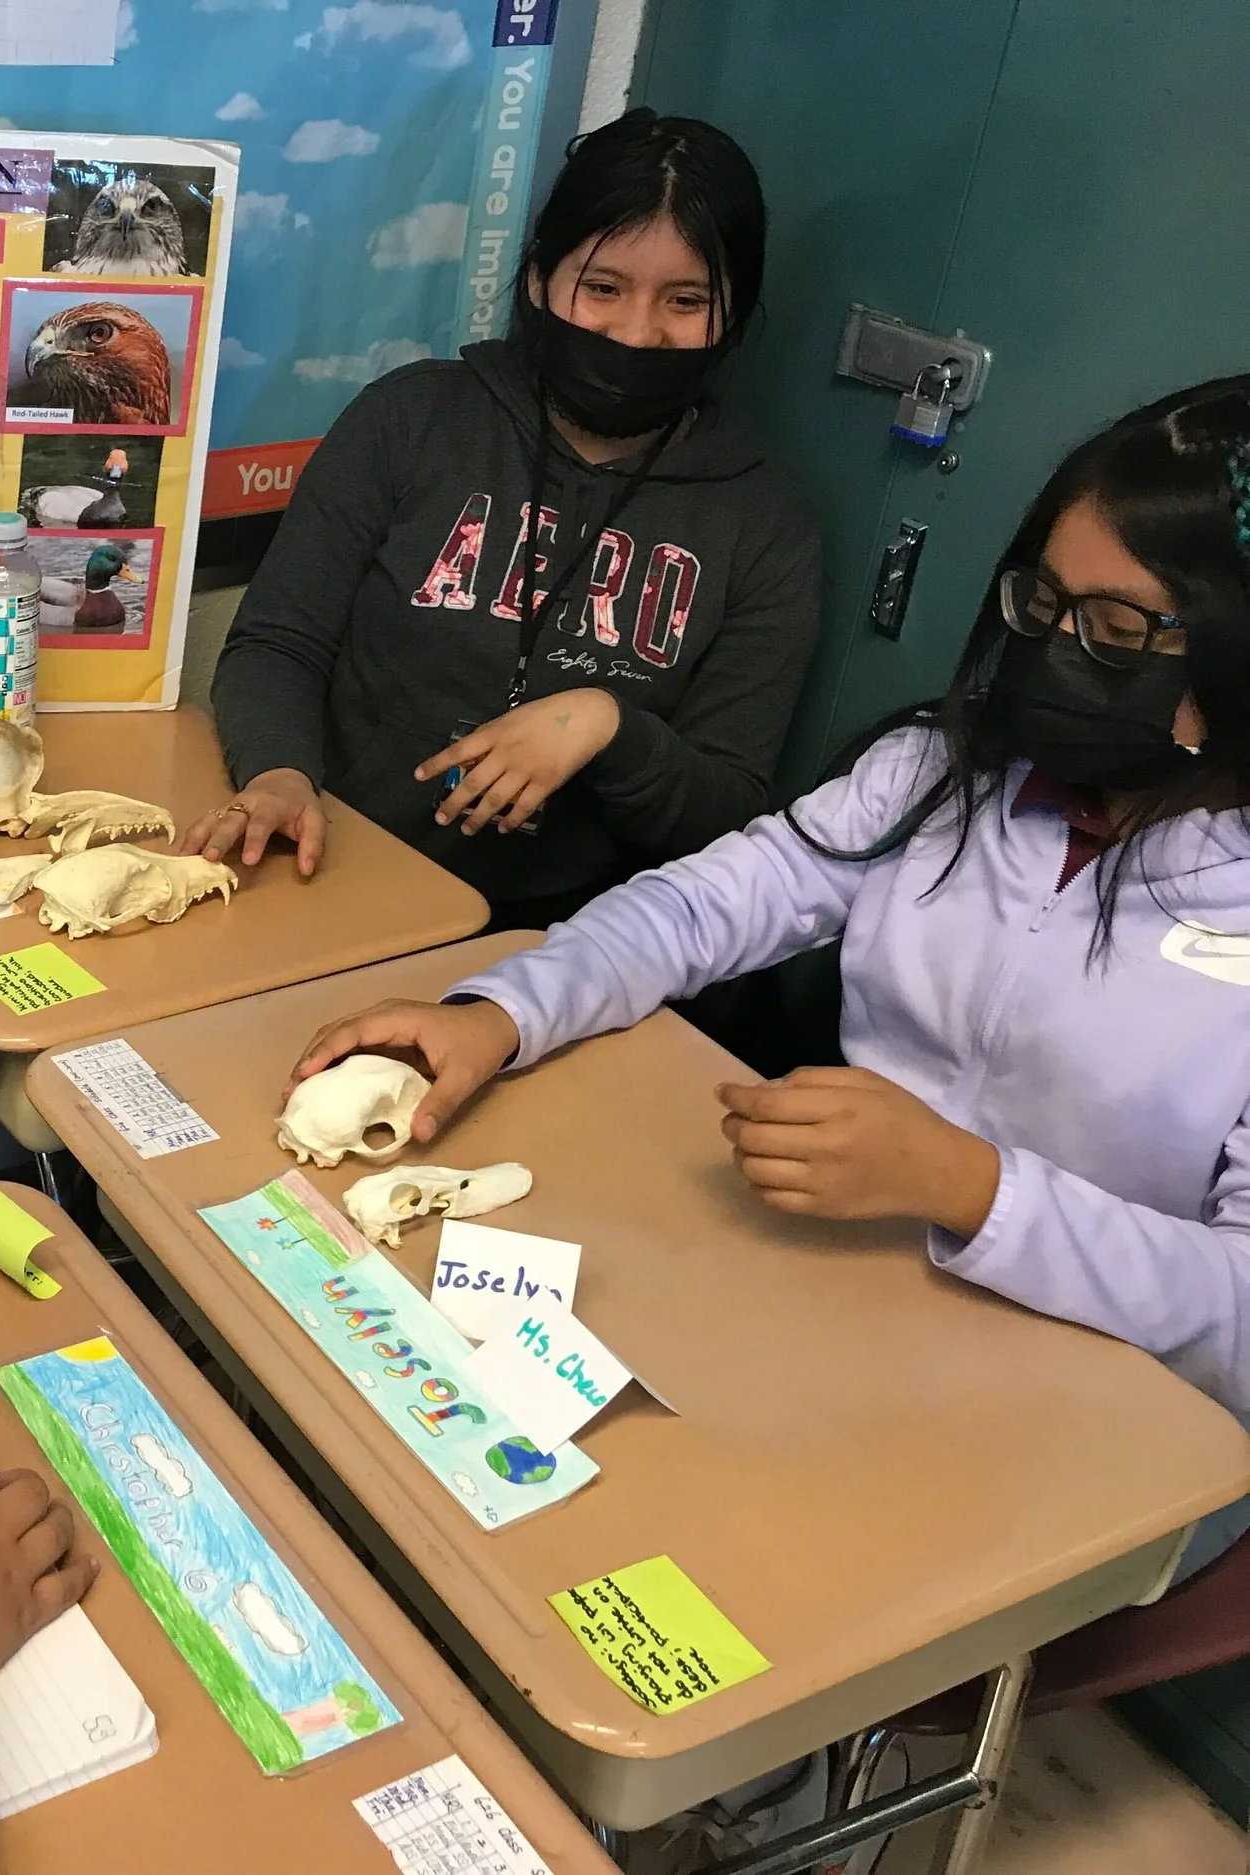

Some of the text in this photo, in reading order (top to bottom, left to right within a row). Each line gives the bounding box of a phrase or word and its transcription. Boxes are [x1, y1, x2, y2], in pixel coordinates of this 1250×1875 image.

[469, 57, 535, 339] You are impor
[12, 409, 69, 420] Red-Tailed Hawk
[238, 462, 293, 495] You
[410, 493, 702, 668] AERO
[24, 1267, 43, 1285] er:
[320, 1275, 488, 1438] Joselyn
[516, 1317, 550, 1363] Ms.
[580, 1625, 598, 1644] no
[602, 1576, 670, 1647] participate
[593, 1587, 694, 1699] do not write on
[689, 1646, 720, 1685] more
[622, 1642, 673, 1706] playing
